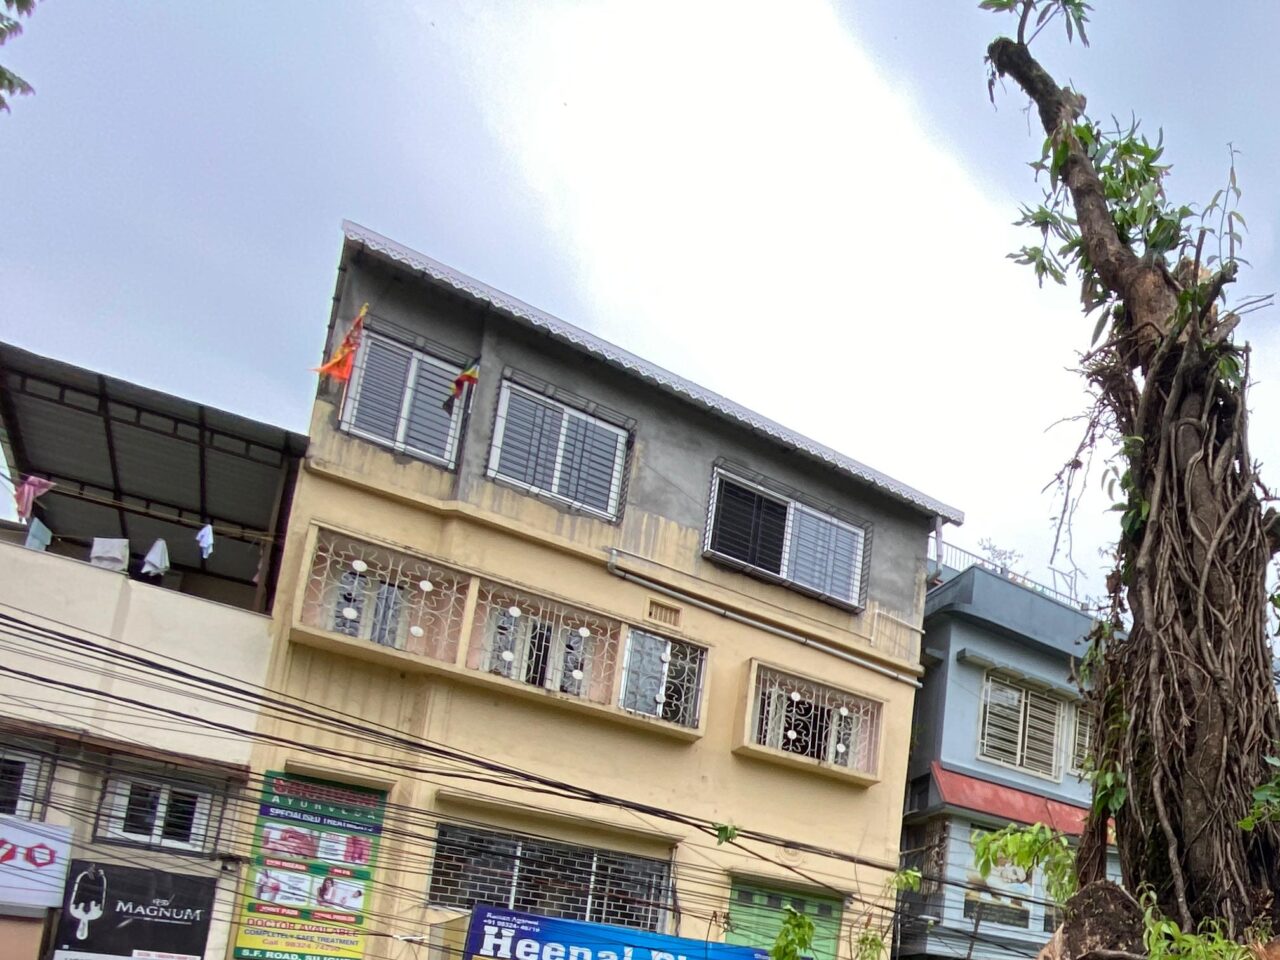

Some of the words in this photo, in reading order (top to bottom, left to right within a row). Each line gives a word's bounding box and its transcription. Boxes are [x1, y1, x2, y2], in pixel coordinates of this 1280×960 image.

[115, 900, 205, 921] MAGNUM
[244, 928, 294, 940] COMPLETELY
[317, 936, 360, 946] TREATMENT
[247, 918, 295, 930] DOCTOR
[300, 924, 360, 938] AVAILABLE
[241, 948, 263, 958] S.F.
